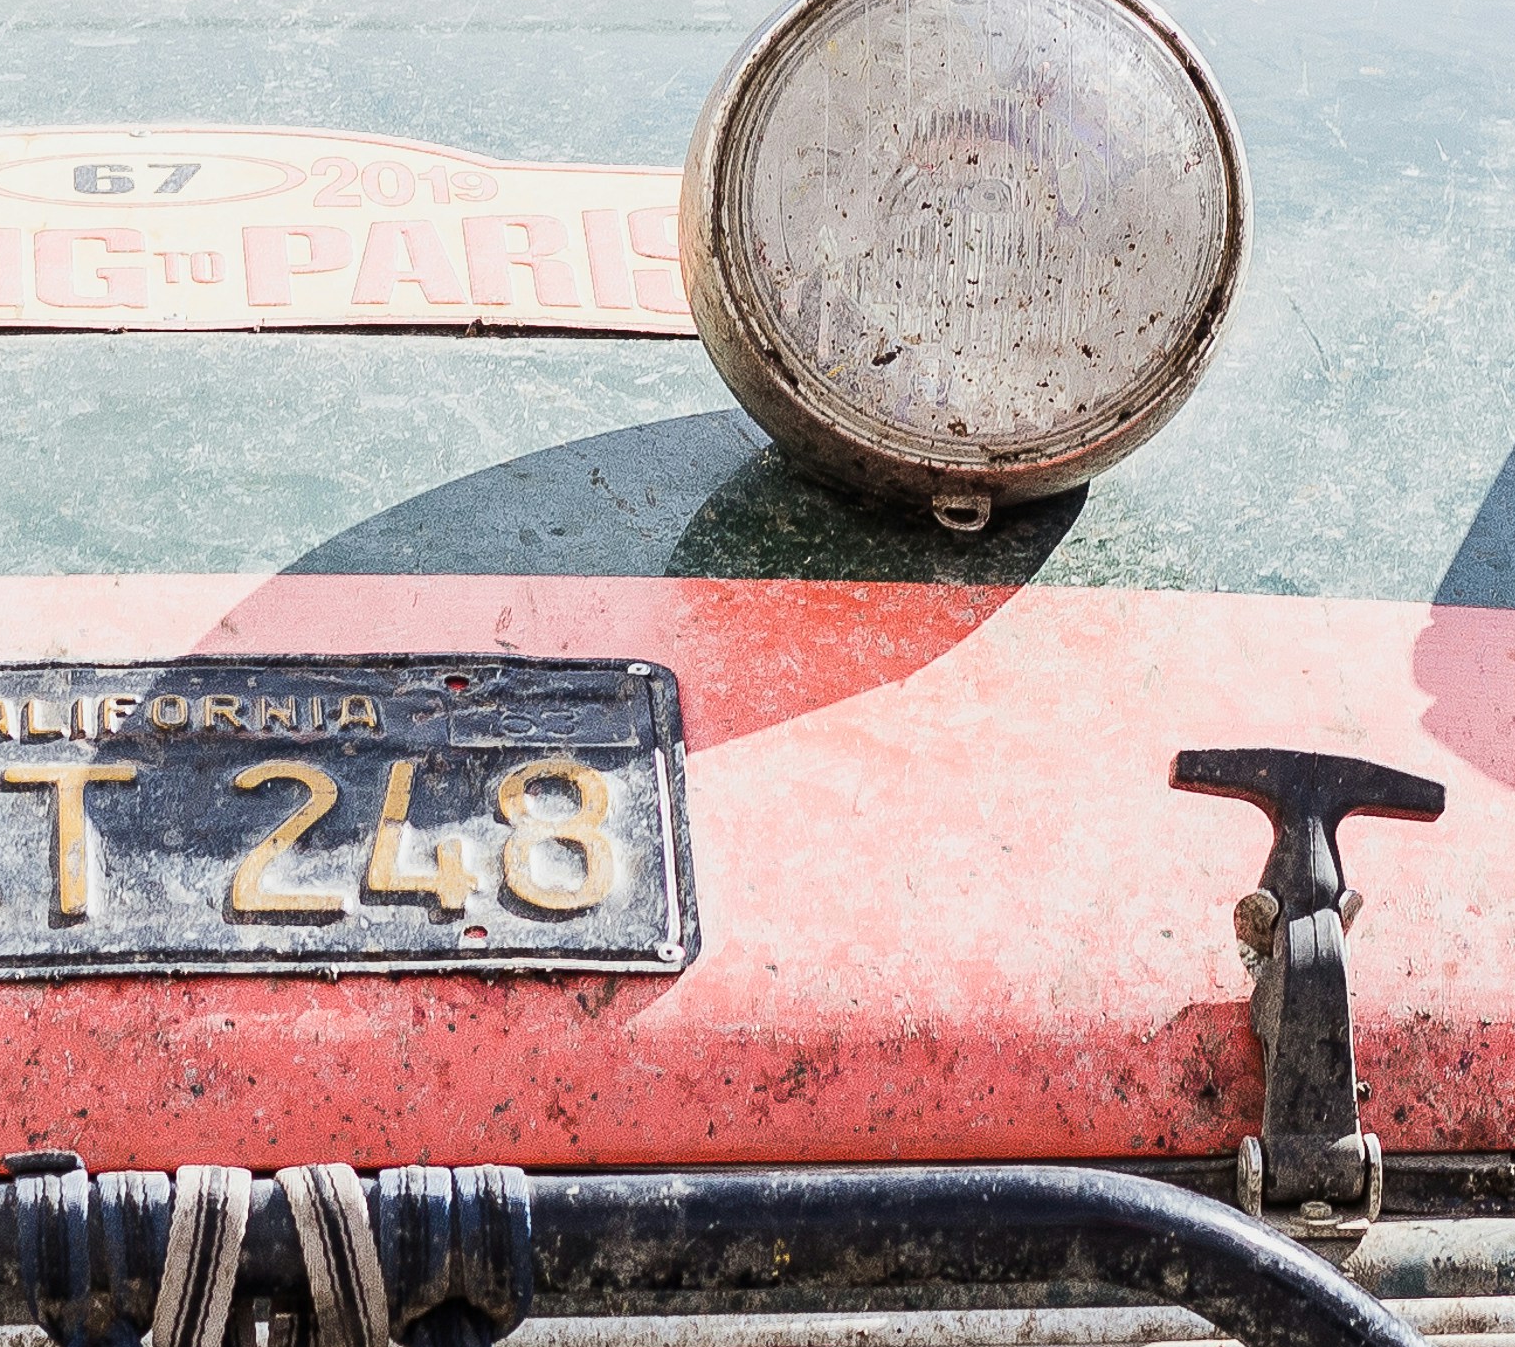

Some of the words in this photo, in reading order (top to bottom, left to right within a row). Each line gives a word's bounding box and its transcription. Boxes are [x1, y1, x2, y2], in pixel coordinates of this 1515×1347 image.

[72, 162, 202, 195] 67
[310, 155, 499, 208] 2019
[153, 250, 227, 284] TO
[241, 205, 692, 315] PARIS
[225, 757, 619, 923] 248
